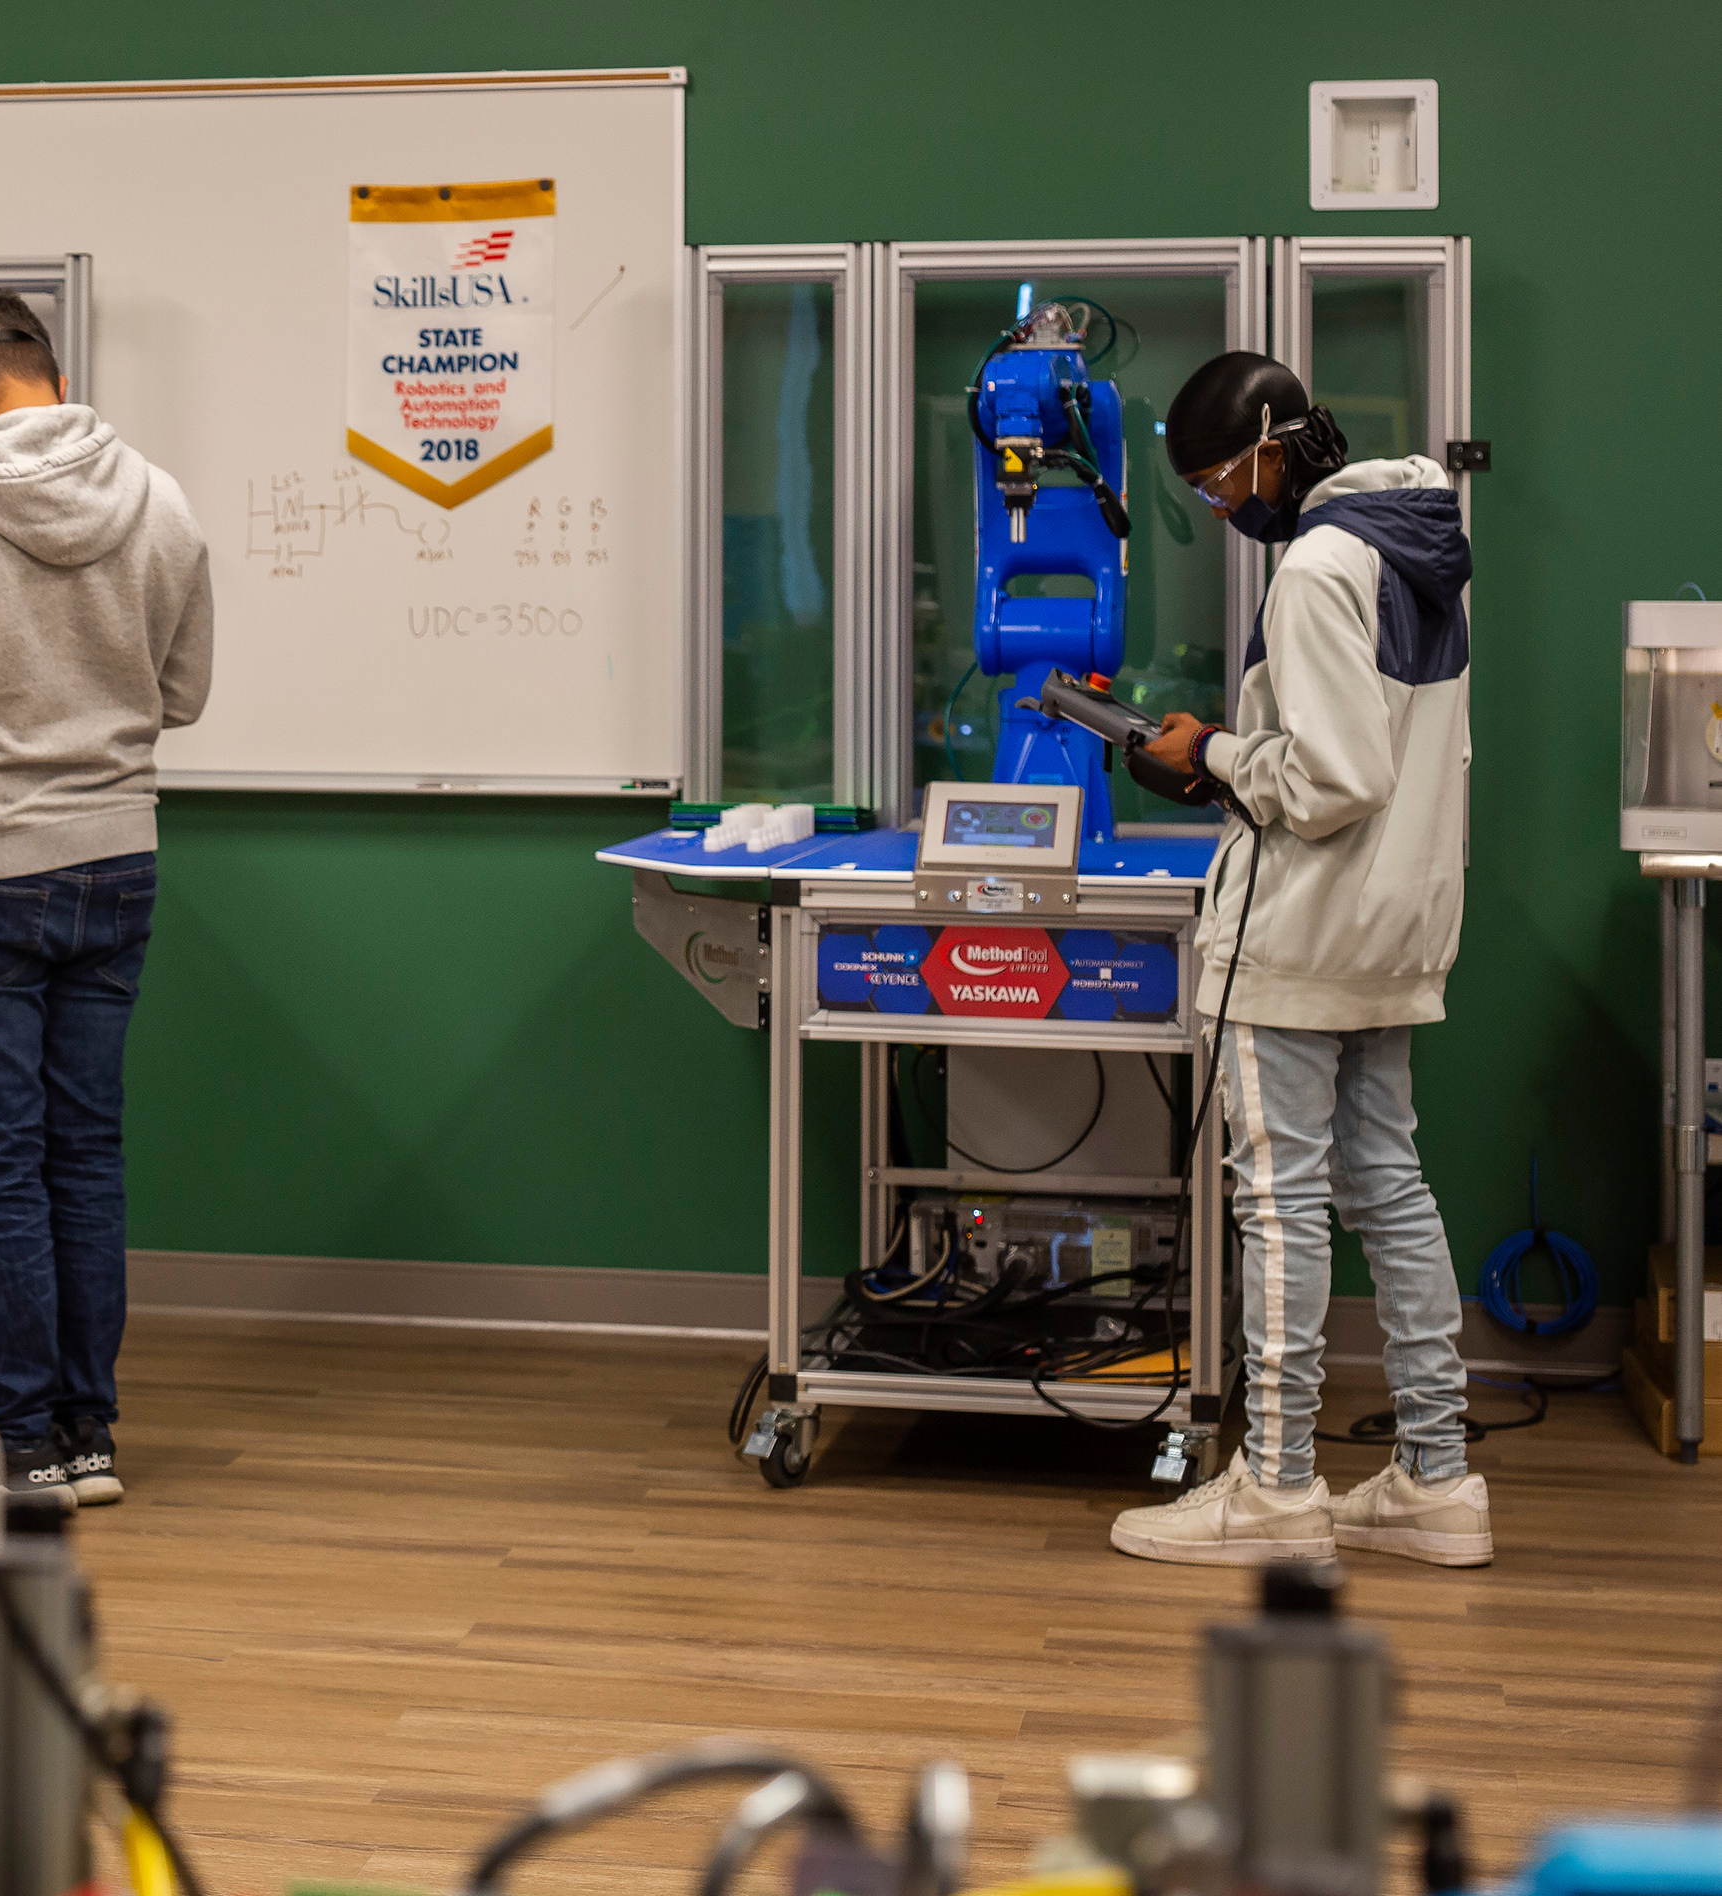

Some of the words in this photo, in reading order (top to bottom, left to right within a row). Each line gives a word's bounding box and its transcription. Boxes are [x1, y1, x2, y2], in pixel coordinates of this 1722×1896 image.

[373, 273, 513, 309] SkillsUSA
[418, 327, 483, 349] STATE
[382, 351, 519, 375] CHAMPION
[394, 379, 467, 396] Robotics
[473, 376, 507, 395] and
[399, 397, 501, 413] Automation
[402, 413, 499, 432] Technology
[420, 438, 480, 462] 2018
[861, 951, 906, 963] SCHUNK
[966, 944, 1048, 963] MethodTool
[1009, 962, 1050, 974] LIMITED
[865, 973, 920, 987] KEYENCE
[948, 983, 1041, 1004] YASKAWA
